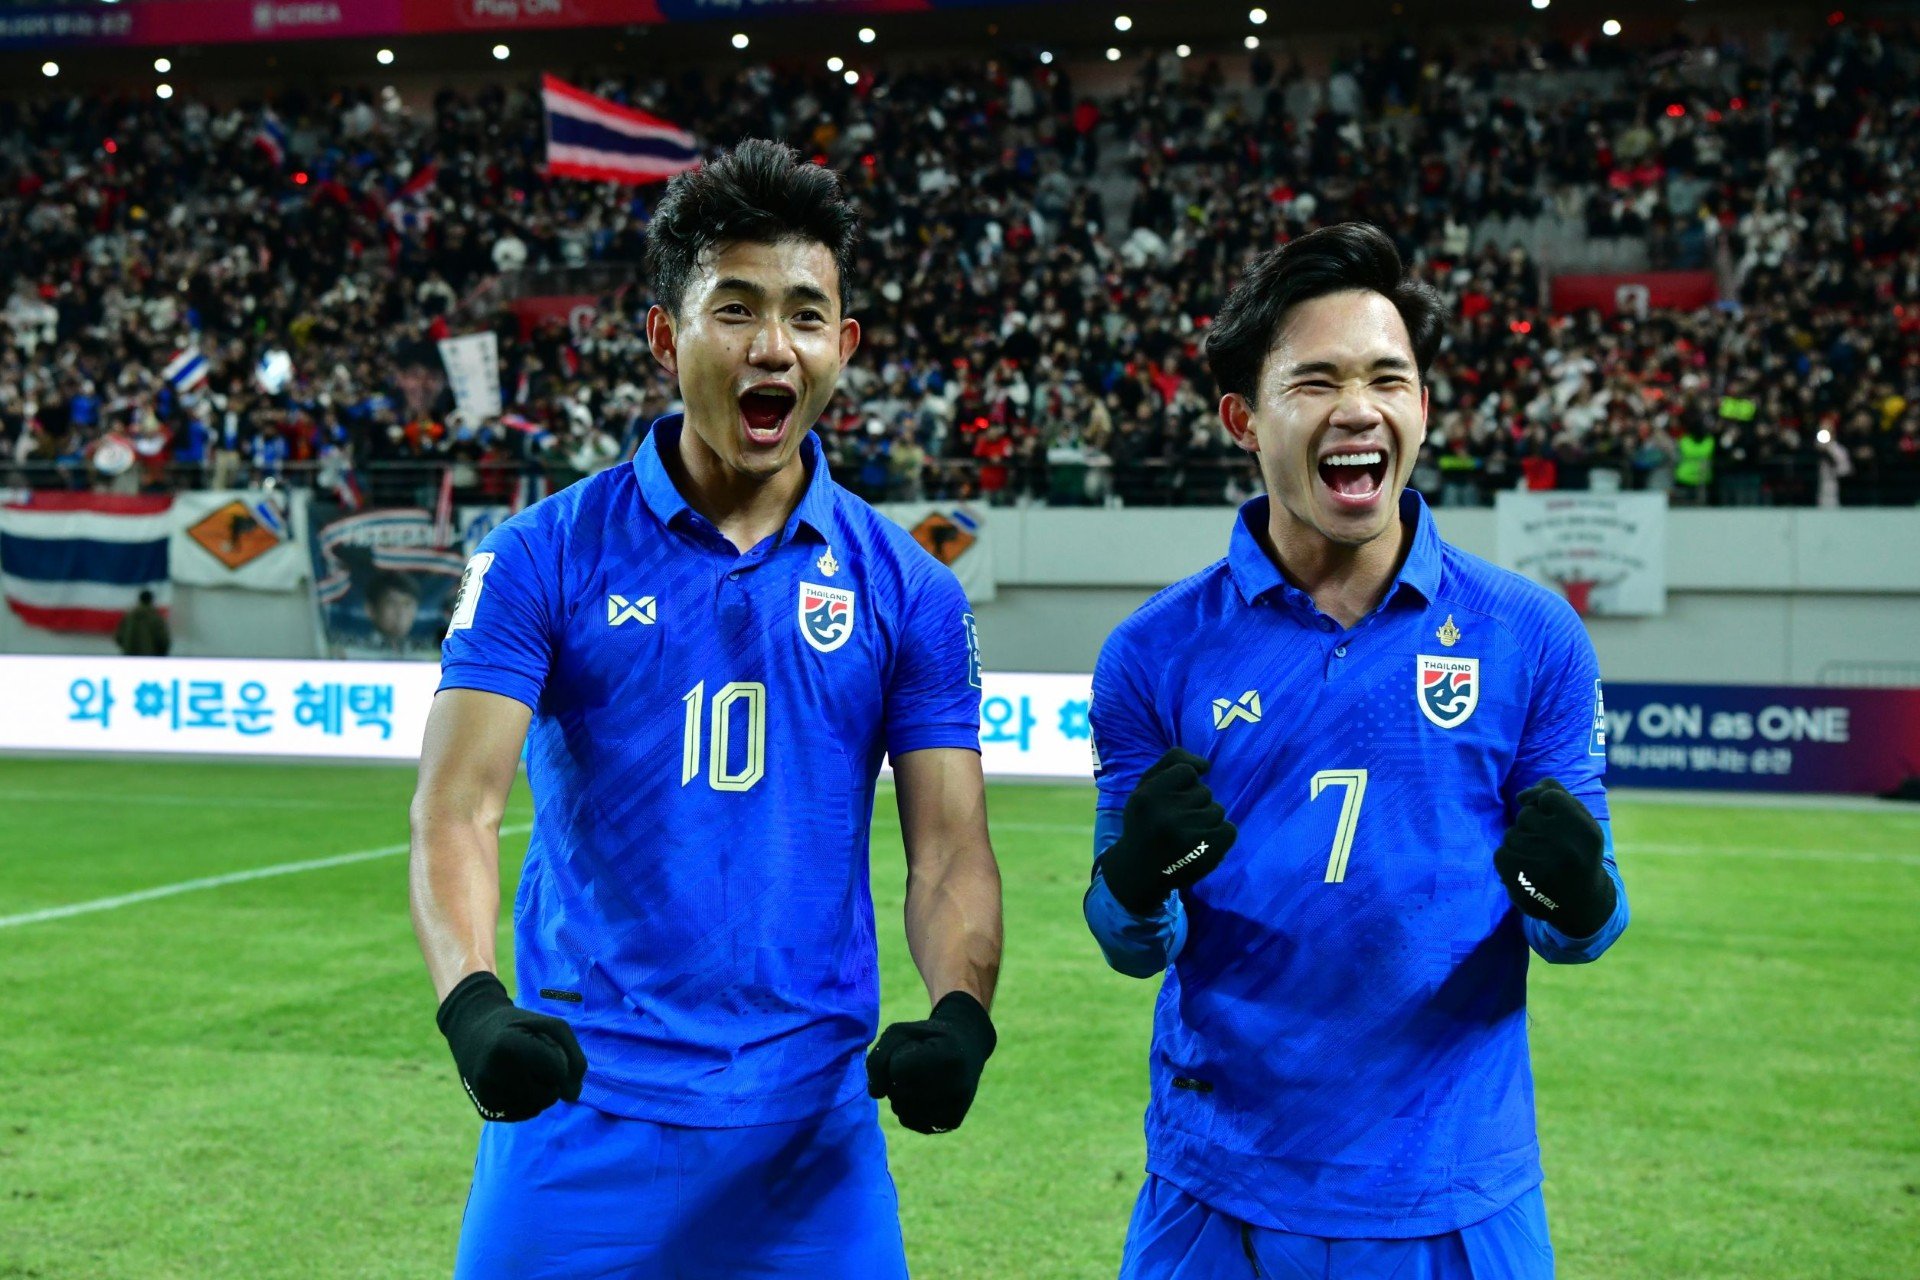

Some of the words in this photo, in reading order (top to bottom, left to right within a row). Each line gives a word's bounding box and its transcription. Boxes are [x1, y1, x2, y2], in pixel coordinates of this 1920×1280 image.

[806, 588, 849, 602] THAILAND
[1424, 661, 1472, 672] THAILAND
[69, 678, 115, 729] 와
[293, 681, 393, 740] 혜택
[982, 696, 1037, 751] 와
[1638, 703, 1702, 738] ON
[1709, 711, 1753, 740] as
[1757, 706, 1849, 743] ONE
[682, 680, 766, 792] 10
[1310, 769, 1367, 883] 7
[1162, 841, 1209, 875] WARRIX
